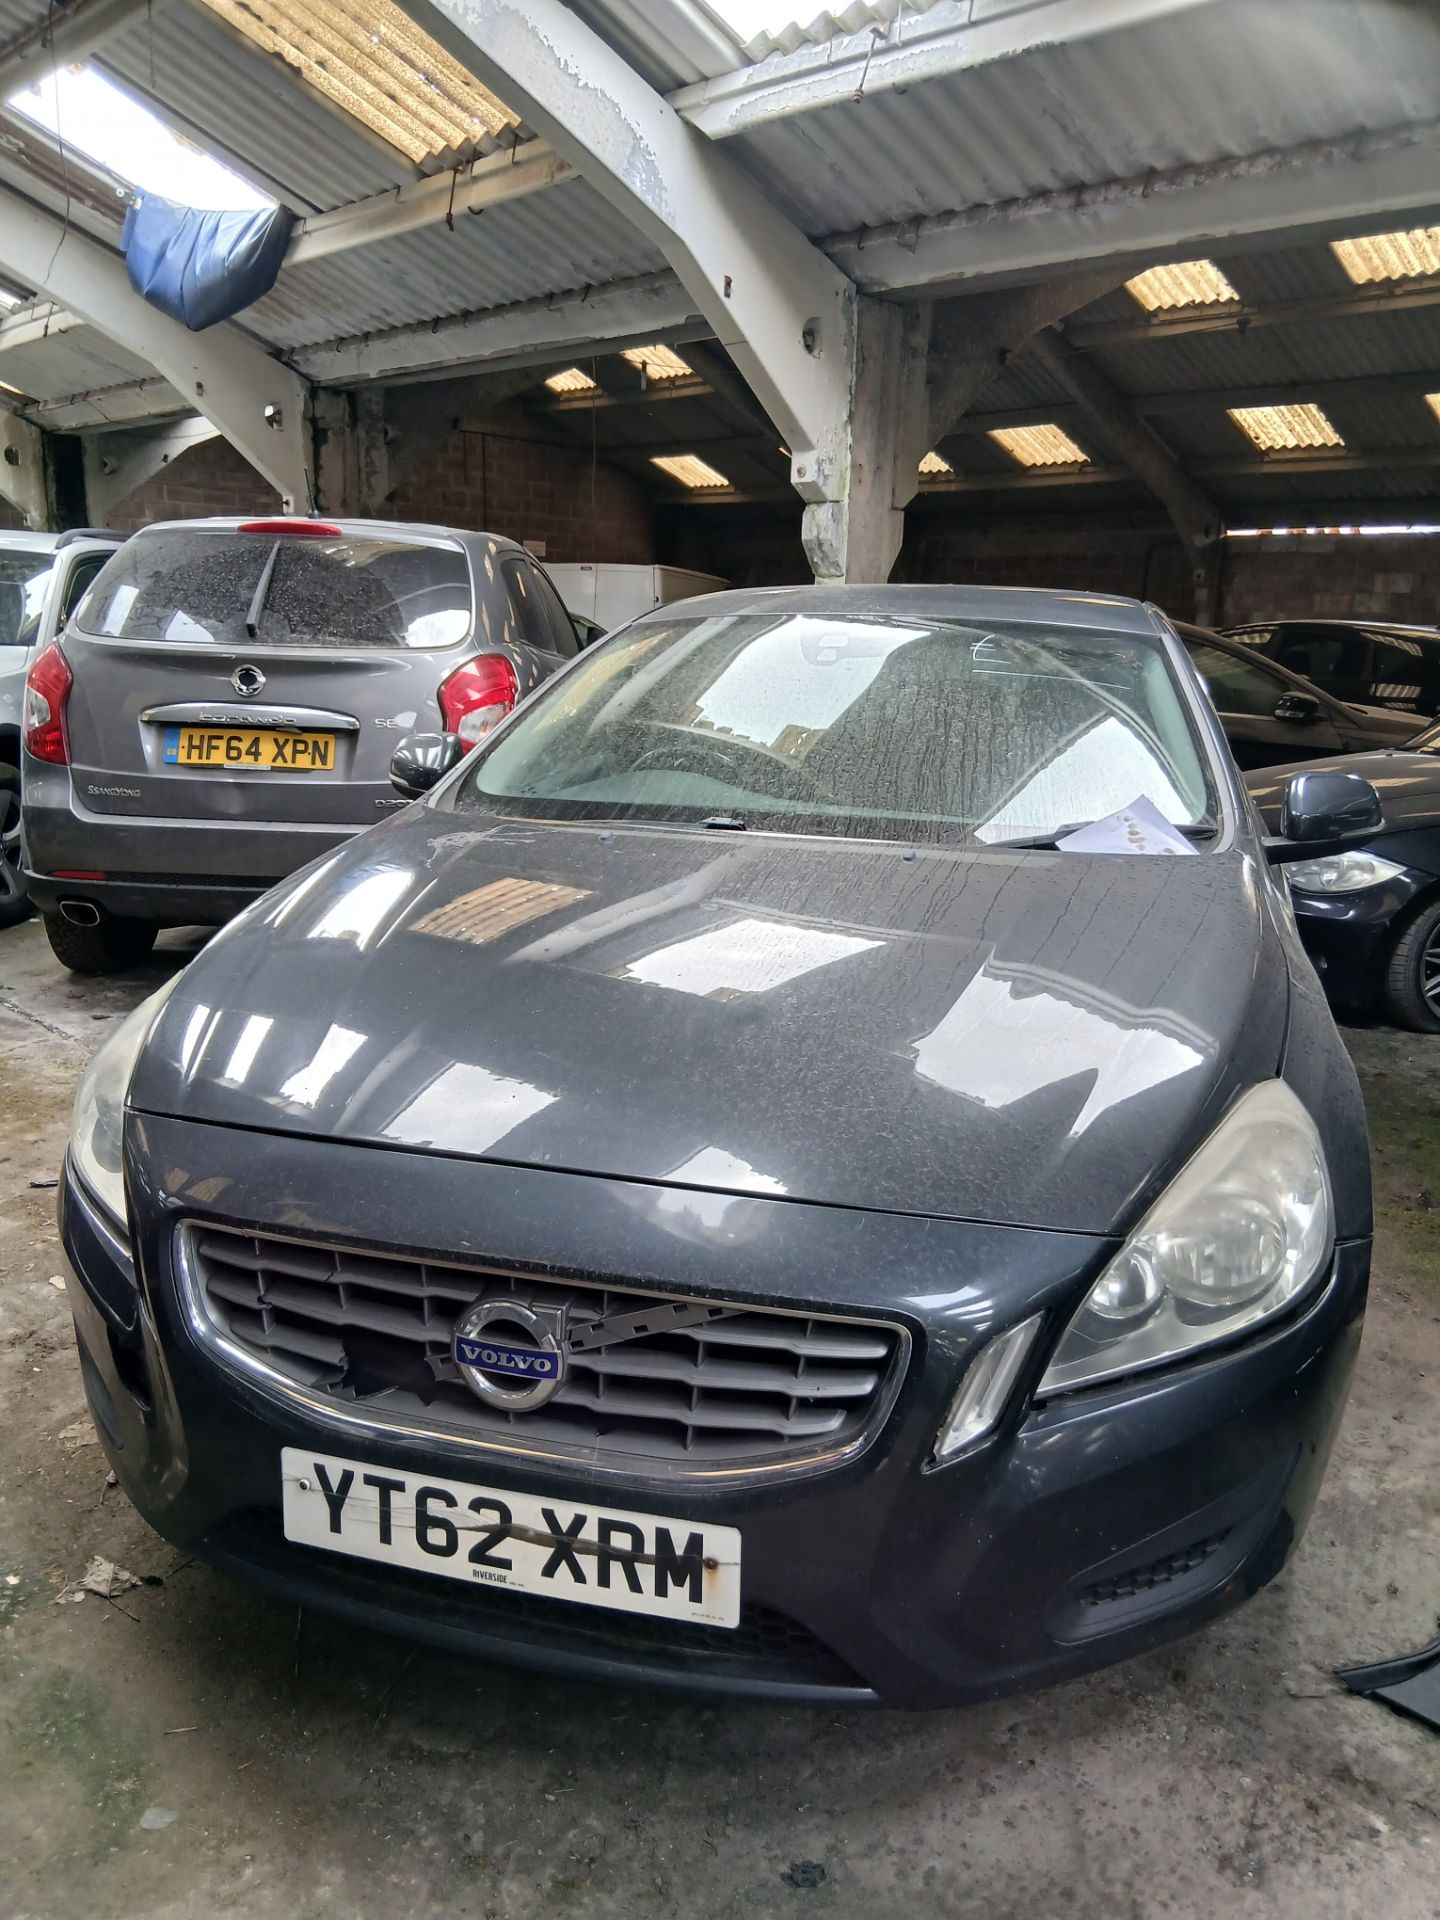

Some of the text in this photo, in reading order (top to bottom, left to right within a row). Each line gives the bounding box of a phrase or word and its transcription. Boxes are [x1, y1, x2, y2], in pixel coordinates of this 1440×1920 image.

[374, 718, 399, 728] SE
[186, 734, 329, 766] HF64 XPN
[460, 1343, 552, 1372] VOLVO
[313, 1462, 704, 1604] YT62 XRM
[472, 1569, 508, 1584] RIVERSIDE
